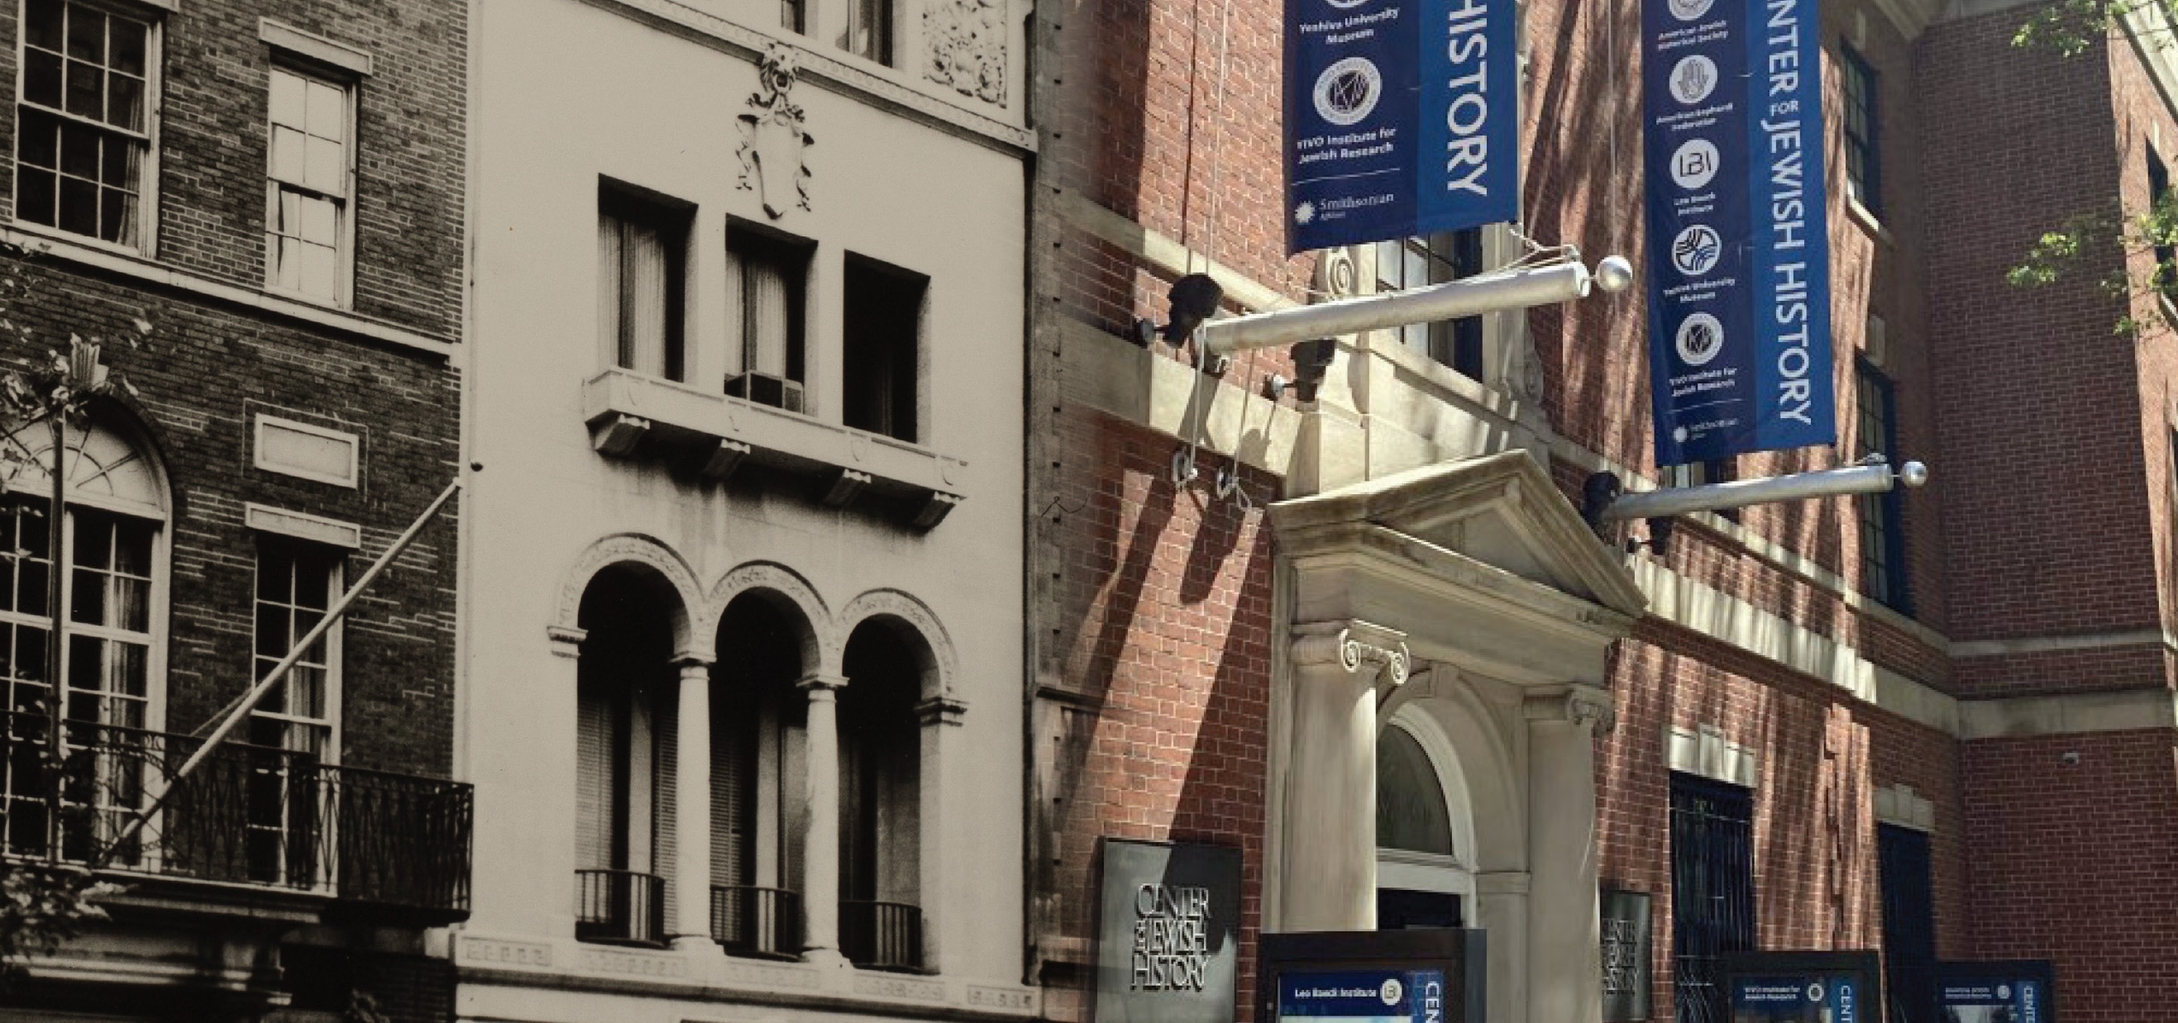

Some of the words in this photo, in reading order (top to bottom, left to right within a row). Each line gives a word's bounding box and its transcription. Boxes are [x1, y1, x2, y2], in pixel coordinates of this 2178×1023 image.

[1299, 20, 1342, 34] Yeshiva
[1344, 7, 1400, 28] University
[1325, 29, 1374, 44] Museum
[1447, 0, 1489, 196] HISTORY
[1769, 100, 1799, 116] FOR
[1326, 131, 1377, 146] Institute
[1379, 126, 1397, 139] for
[1298, 148, 1337, 164] Jewish
[1340, 142, 1394, 158] Research
[1679, 150, 1711, 177] LBI
[1760, 120, 1805, 250] JEWISH
[1773, 261, 1812, 426] HISTORY
[1137, 882, 1211, 918] CENTER
[1131, 952, 1211, 989] HISTORY
[1295, 987, 1311, 998] Leo
[1425, 981, 1440, 1023] CEN
